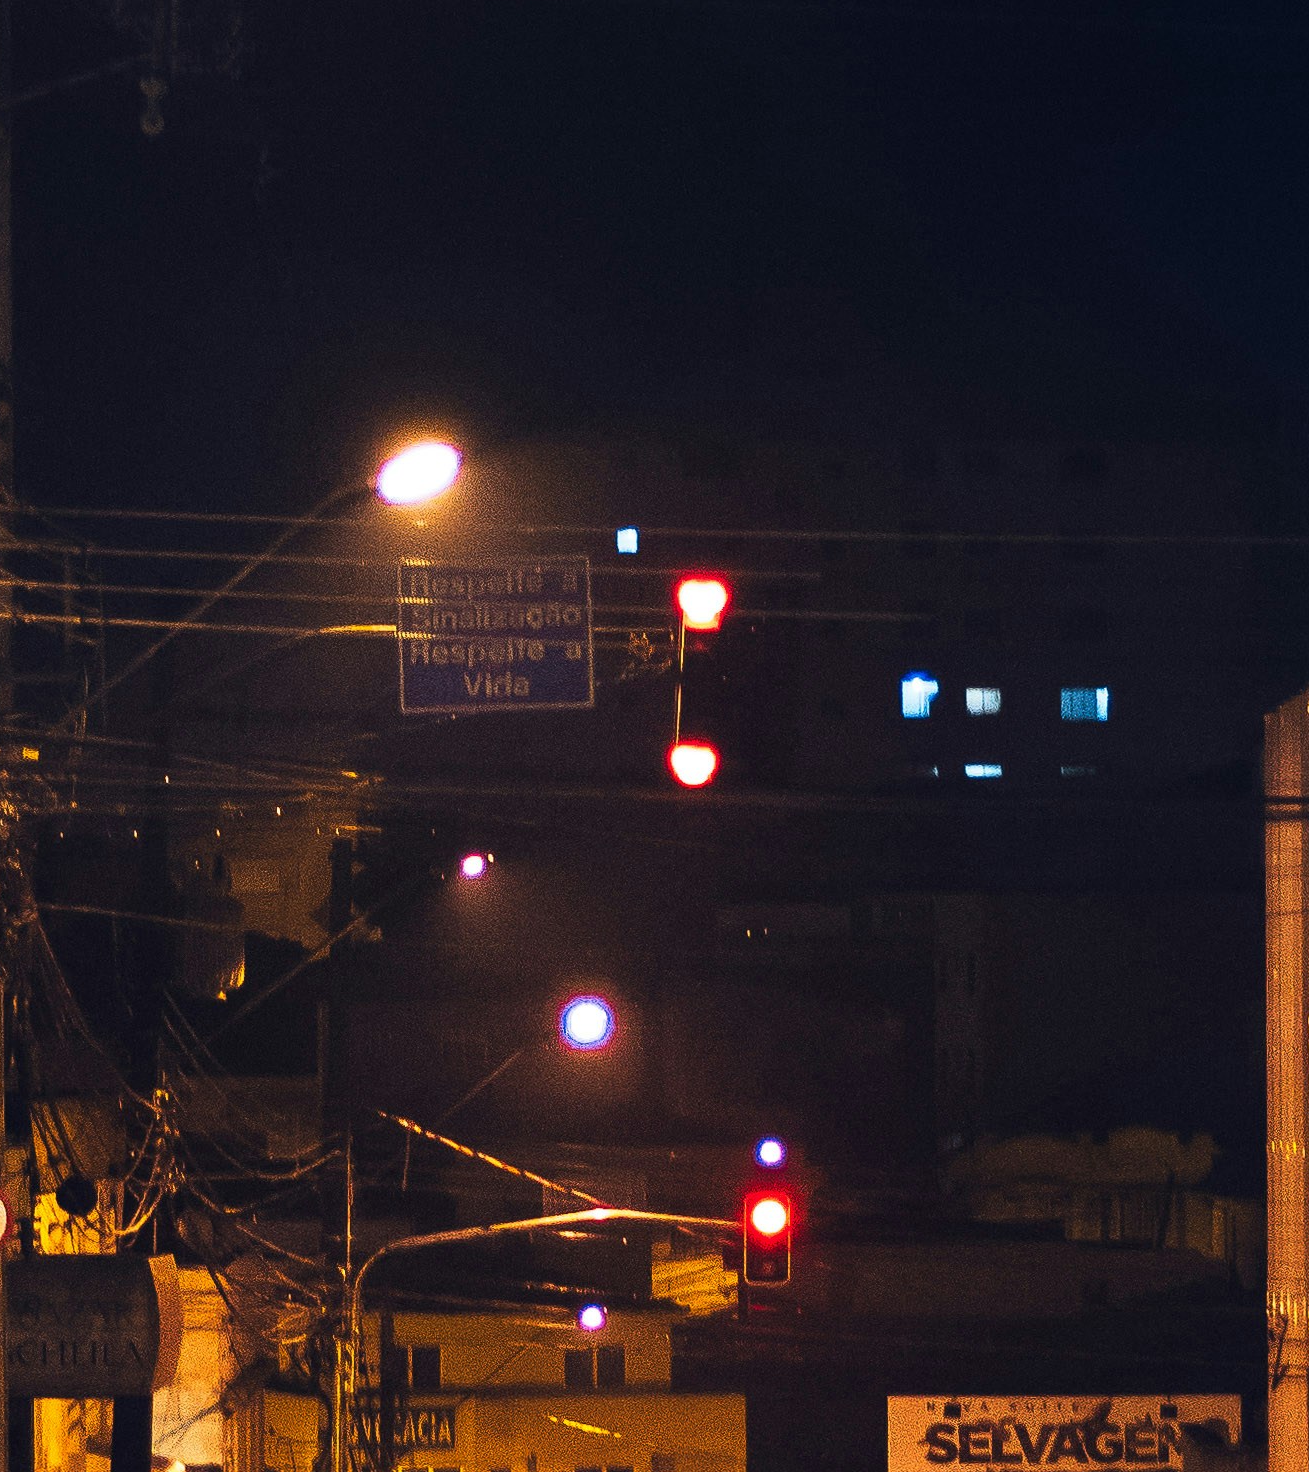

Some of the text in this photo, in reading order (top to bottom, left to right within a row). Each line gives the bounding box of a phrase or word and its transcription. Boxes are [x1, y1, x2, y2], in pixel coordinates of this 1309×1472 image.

[410, 566, 544, 600] Respeite
[411, 603, 582, 630] Sinalização
[410, 638, 545, 668] Respeite
[463, 671, 530, 698] Vida
[926, 1400, 989, 1412] NVA
